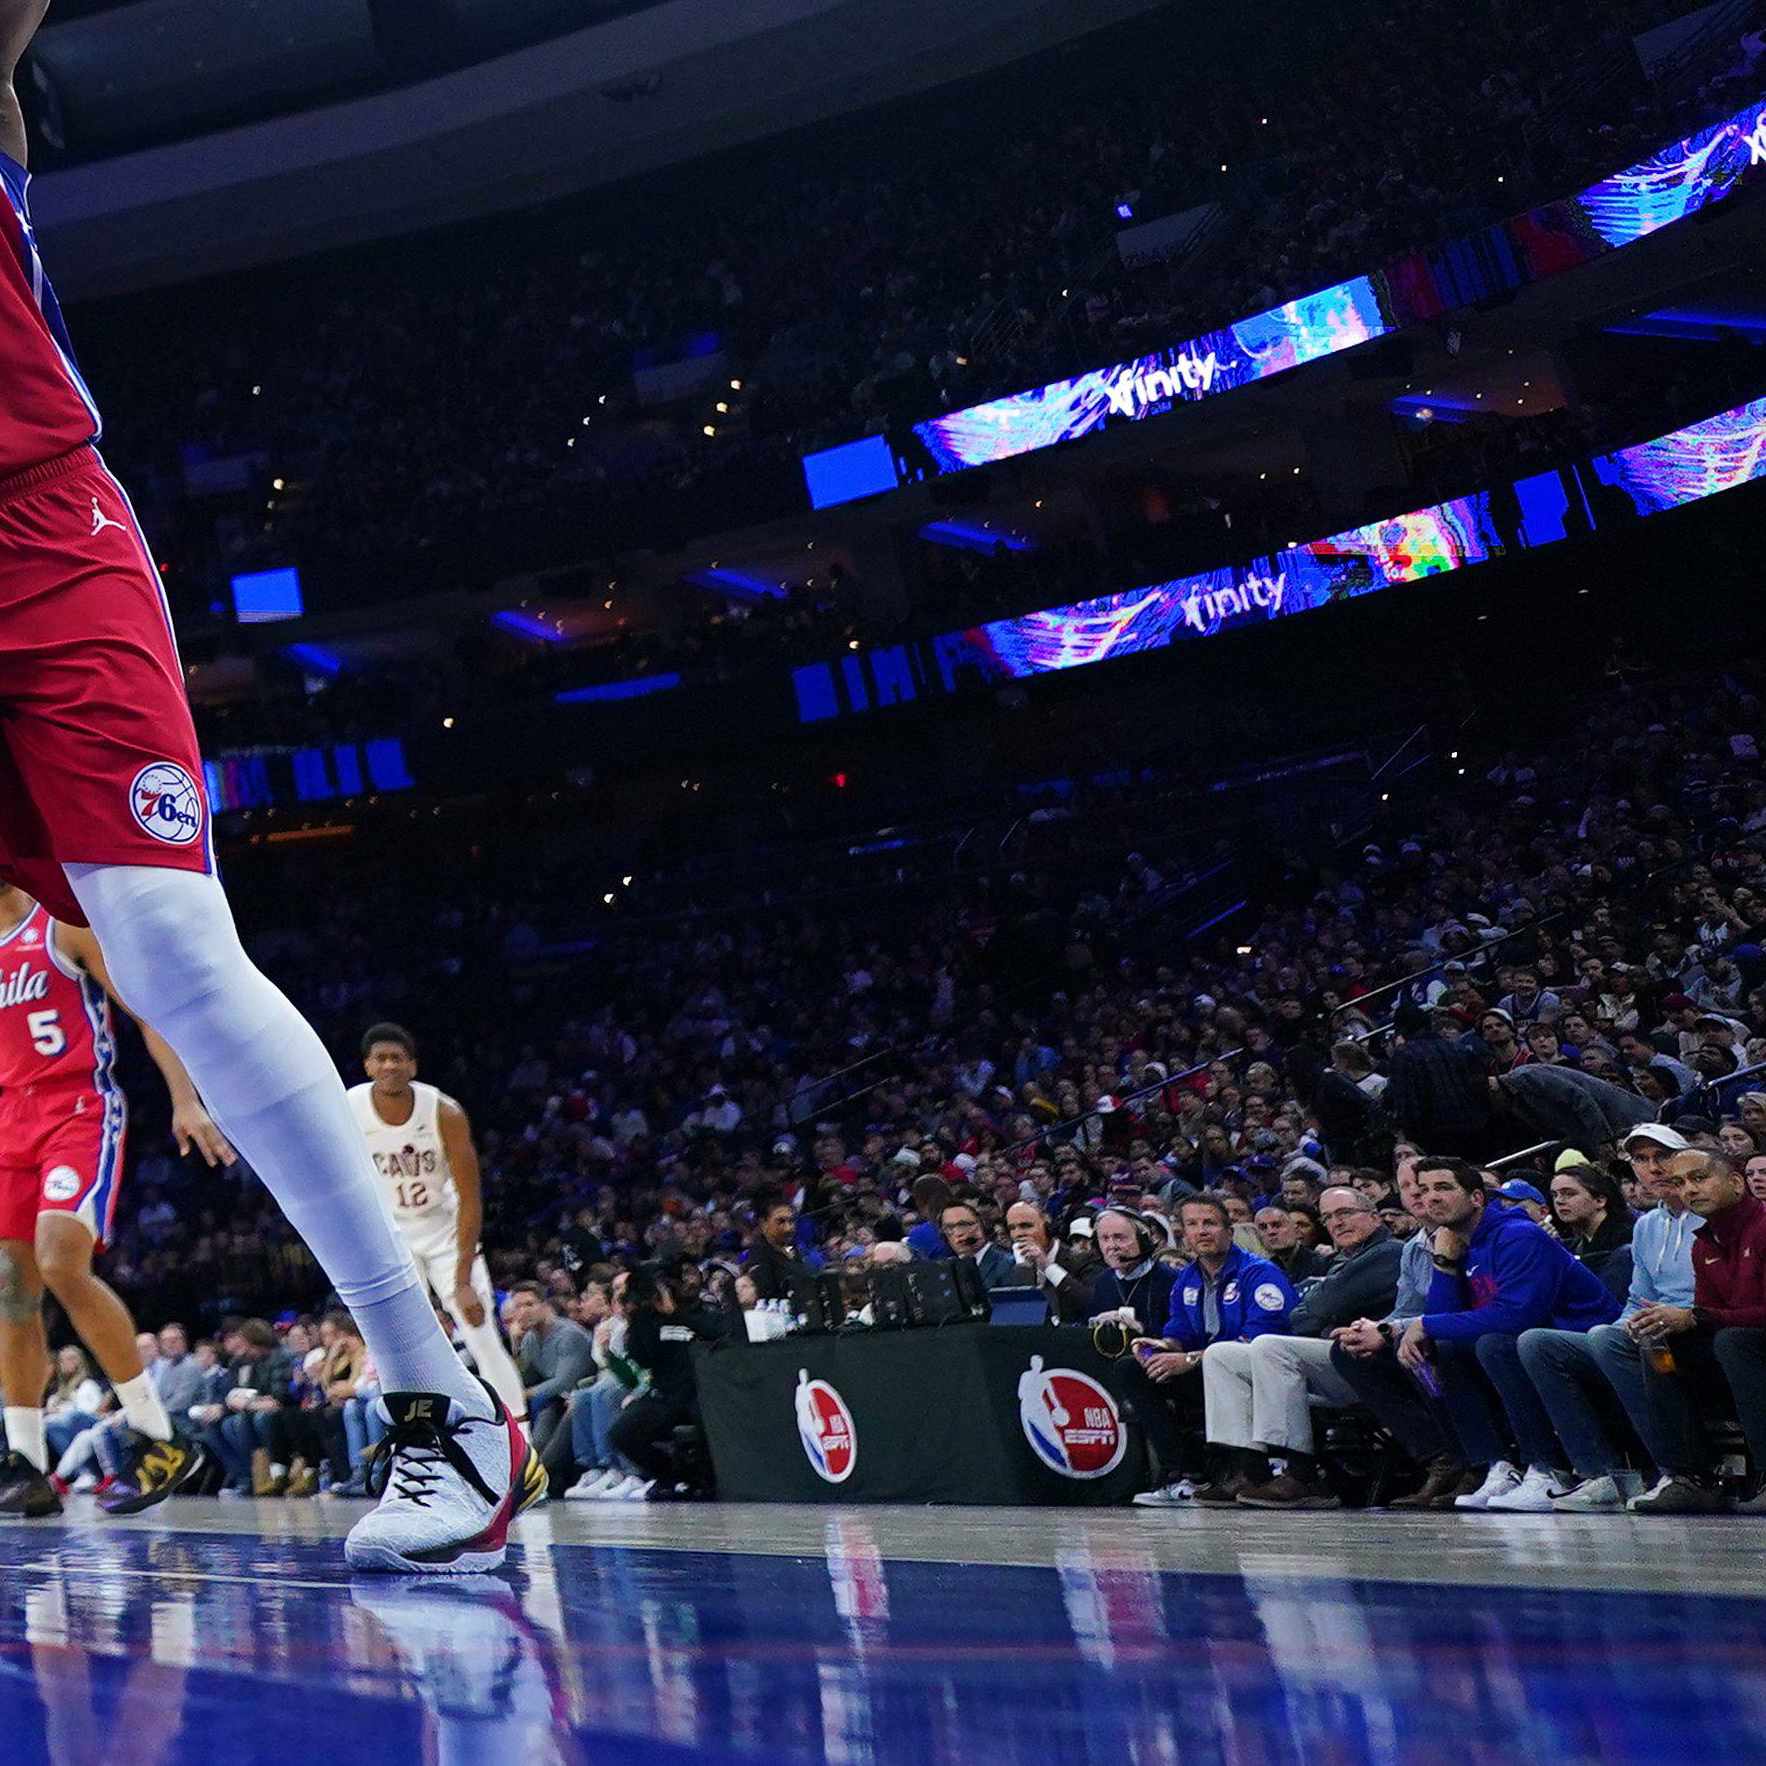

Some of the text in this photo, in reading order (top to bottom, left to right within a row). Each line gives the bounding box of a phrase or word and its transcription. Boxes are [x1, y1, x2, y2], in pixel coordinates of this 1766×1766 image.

[1105, 348, 1218, 420] xfinity
[27, 1009, 66, 1056] 5
[372, 1149, 436, 1178] CAVS
[396, 1181, 429, 1208] 12
[405, 1398, 434, 1423] JE
[1084, 1407, 1110, 1428] NBA
[822, 1434, 851, 1451] ESPN
[1064, 1427, 1117, 1447] ESPN
